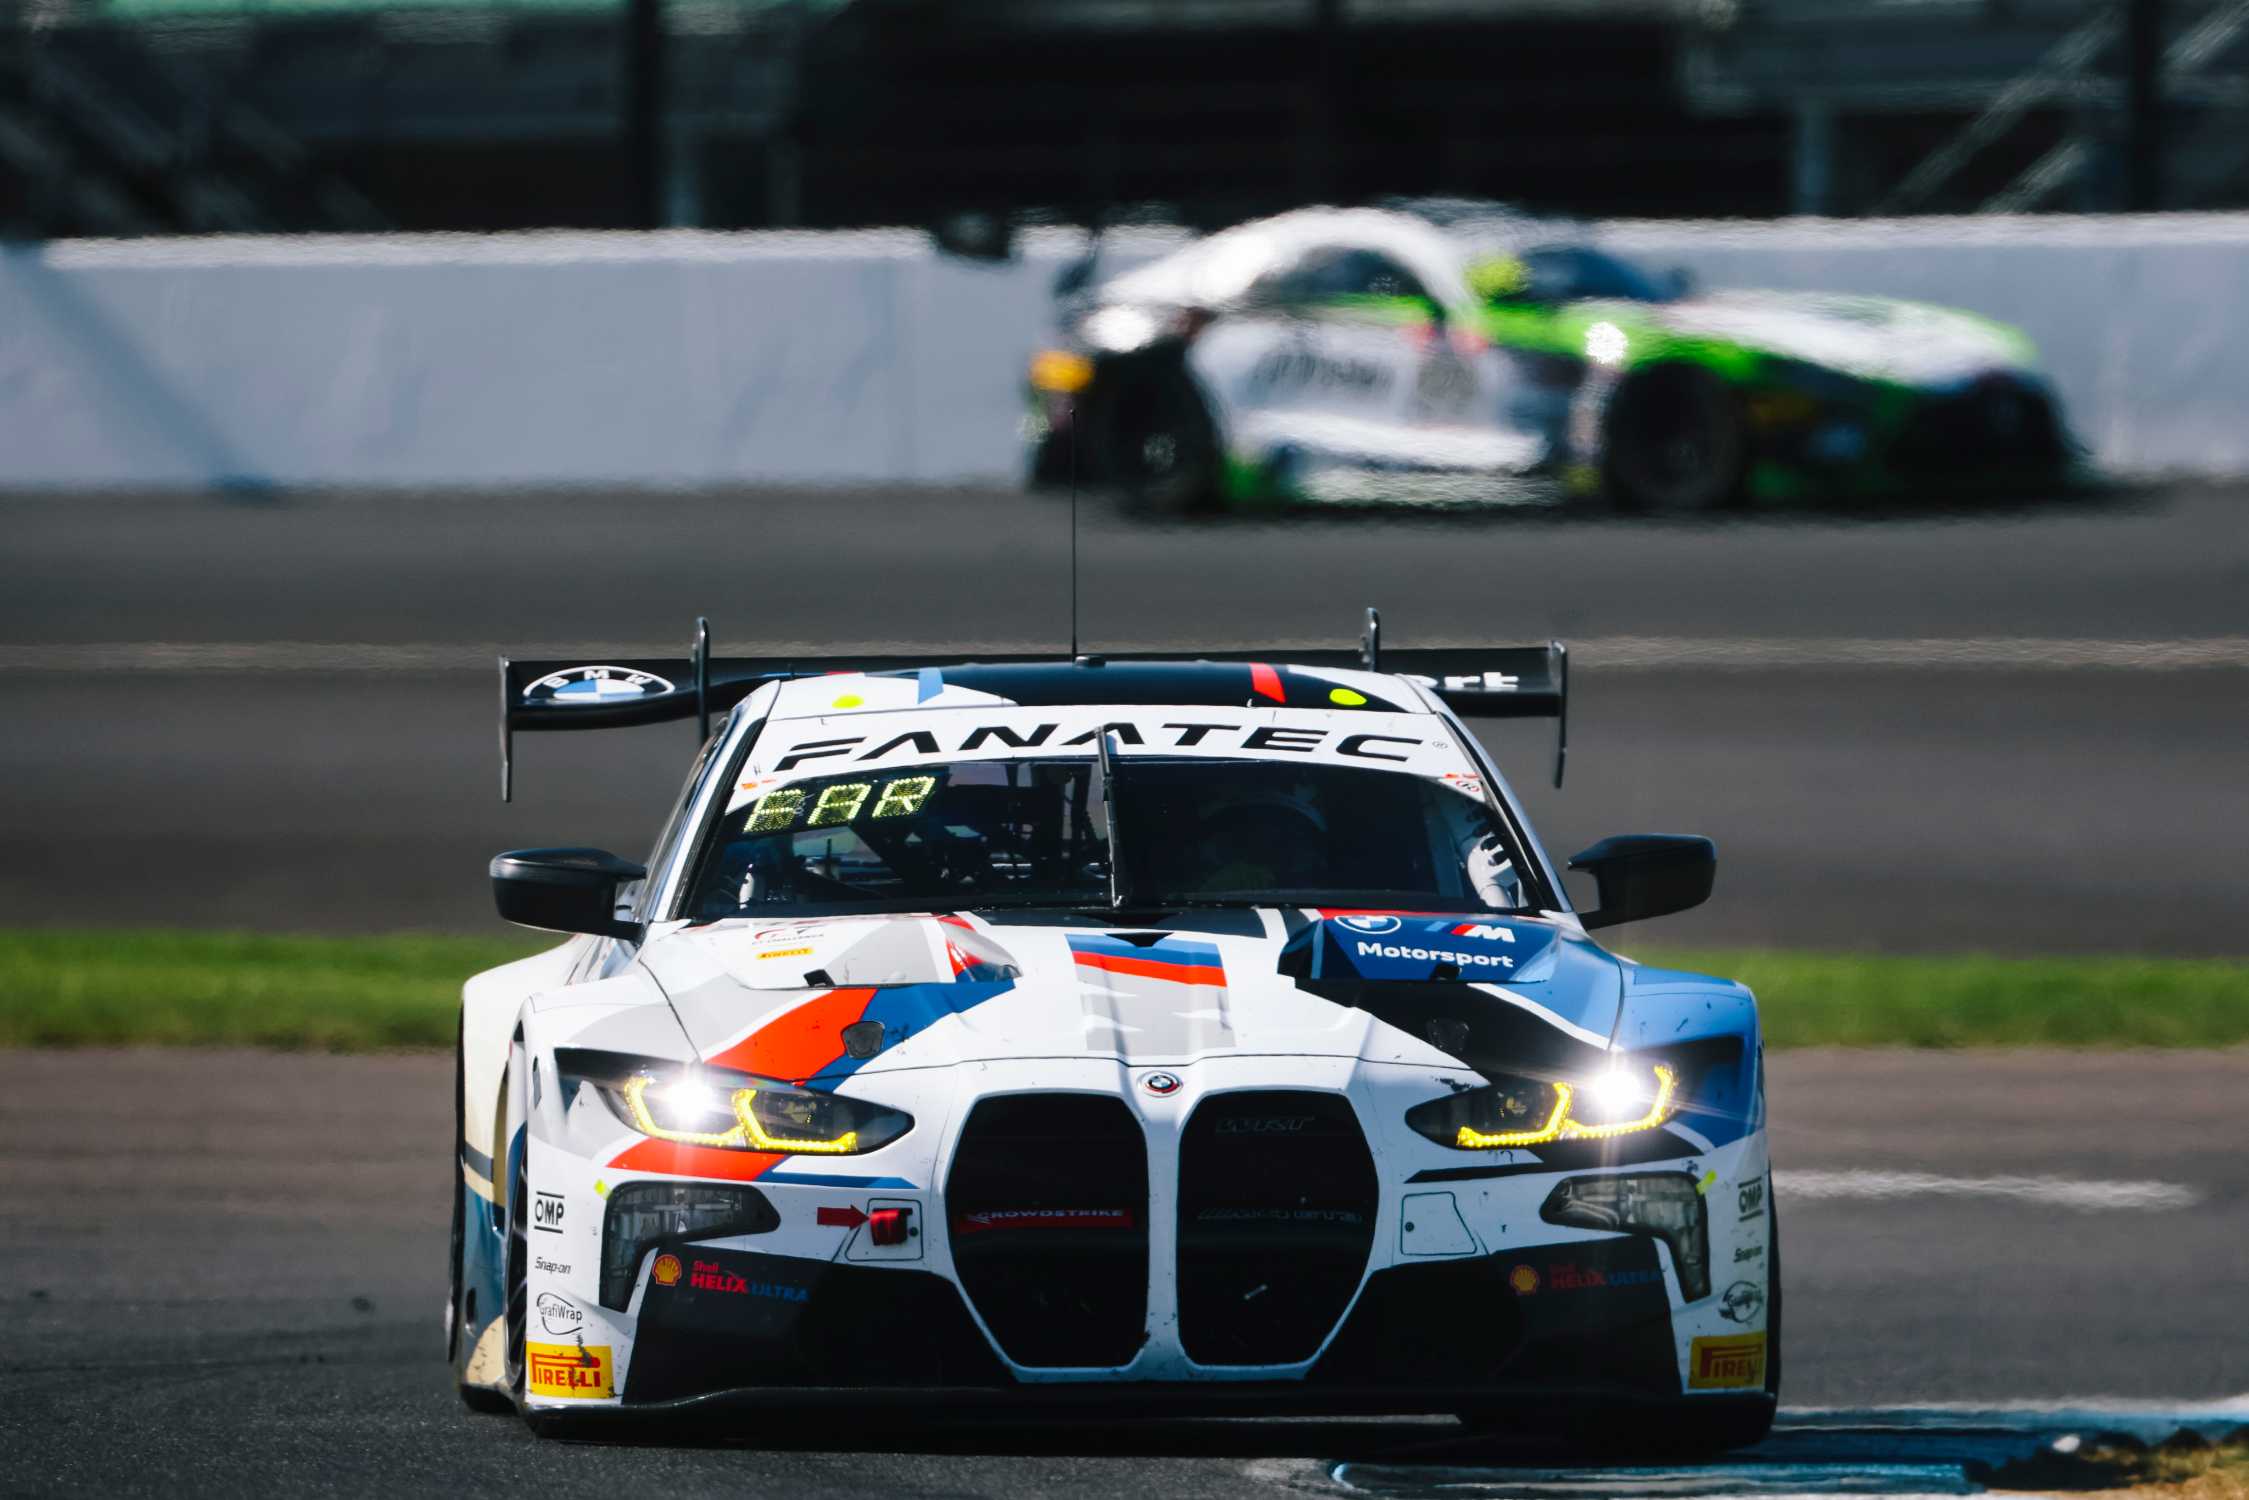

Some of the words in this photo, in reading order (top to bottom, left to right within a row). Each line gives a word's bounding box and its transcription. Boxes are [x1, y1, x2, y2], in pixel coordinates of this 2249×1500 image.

[771, 722, 1422, 772] FANATEC
[743, 776, 936, 832] FAR
[1356, 941, 1514, 968] Motorsport
[535, 1199, 564, 1225] OMP
[535, 1256, 572, 1274] Snap-on
[690, 1272, 749, 1294] HELIX
[540, 1301, 583, 1324] GrafiWrap
[531, 1352, 601, 1388] PIRELLI
